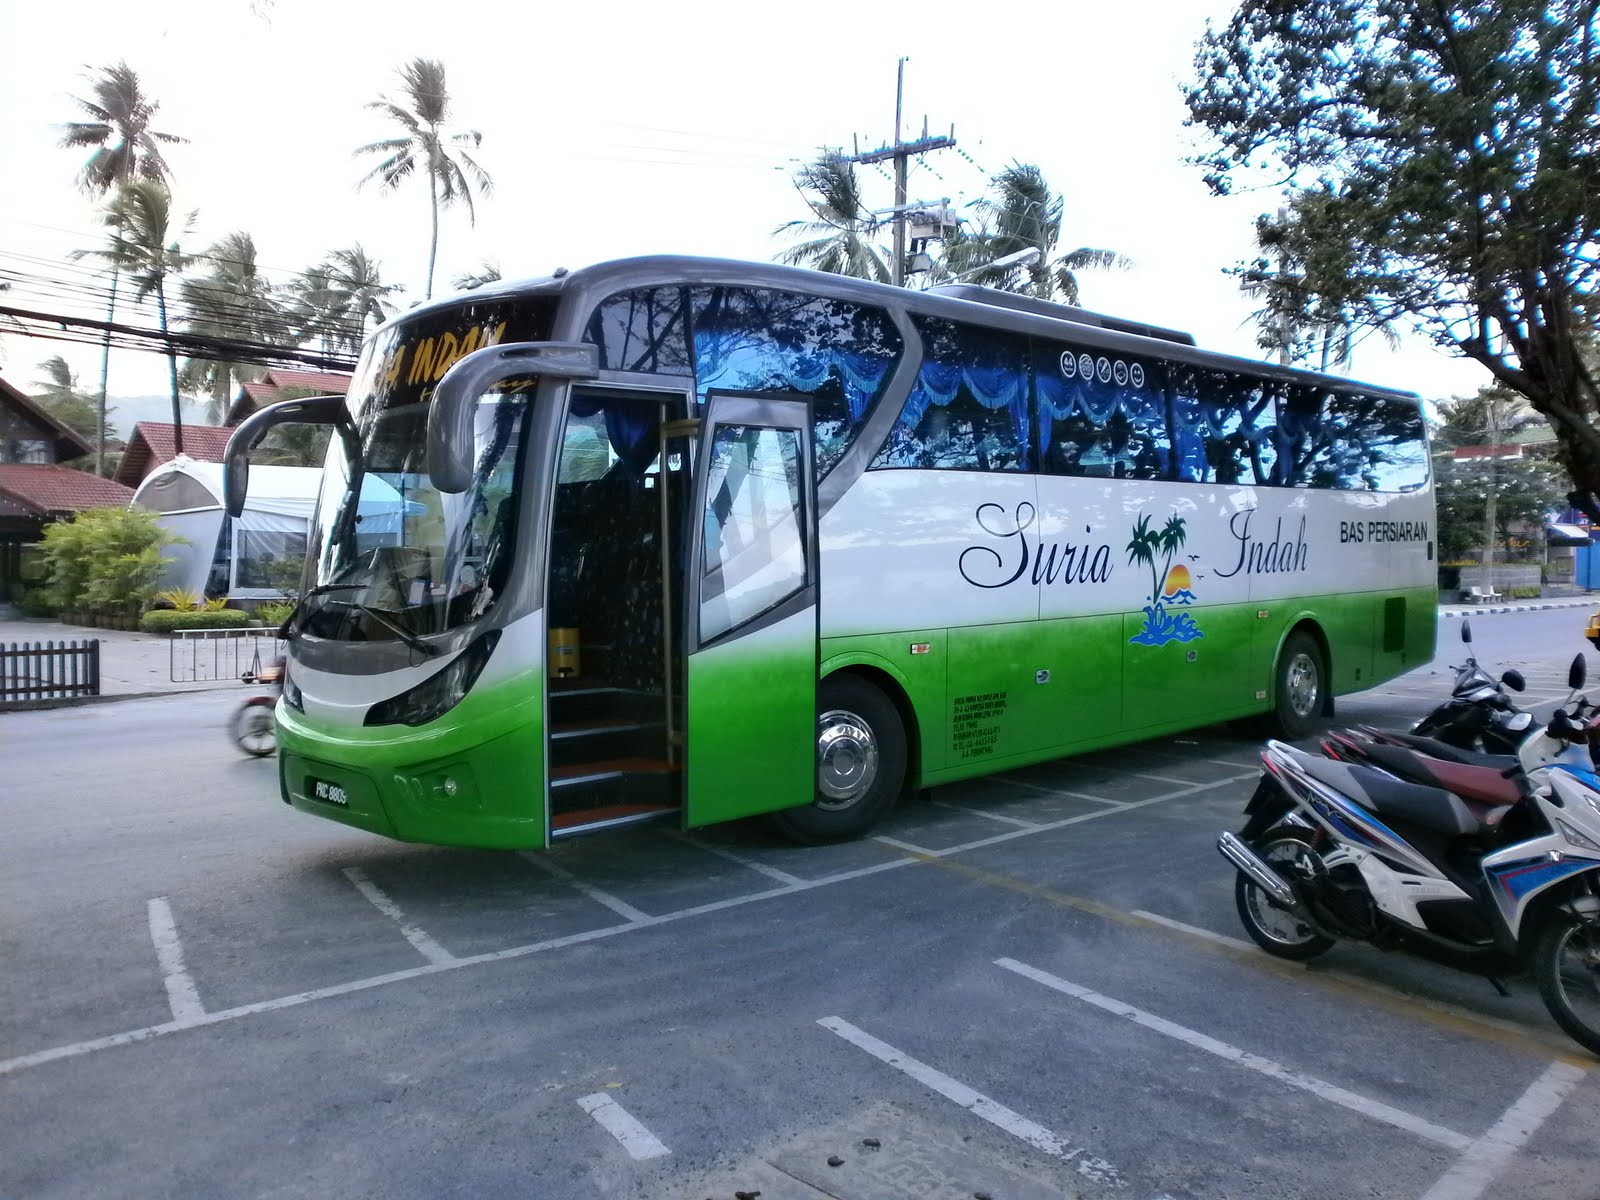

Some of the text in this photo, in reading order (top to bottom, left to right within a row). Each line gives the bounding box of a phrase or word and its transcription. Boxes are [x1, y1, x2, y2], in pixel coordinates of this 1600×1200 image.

[1340, 521, 1428, 543] BAS PERSIARAN
[959, 501, 1308, 588] Suria Indah
[316, 781, 328, 798] PKC
